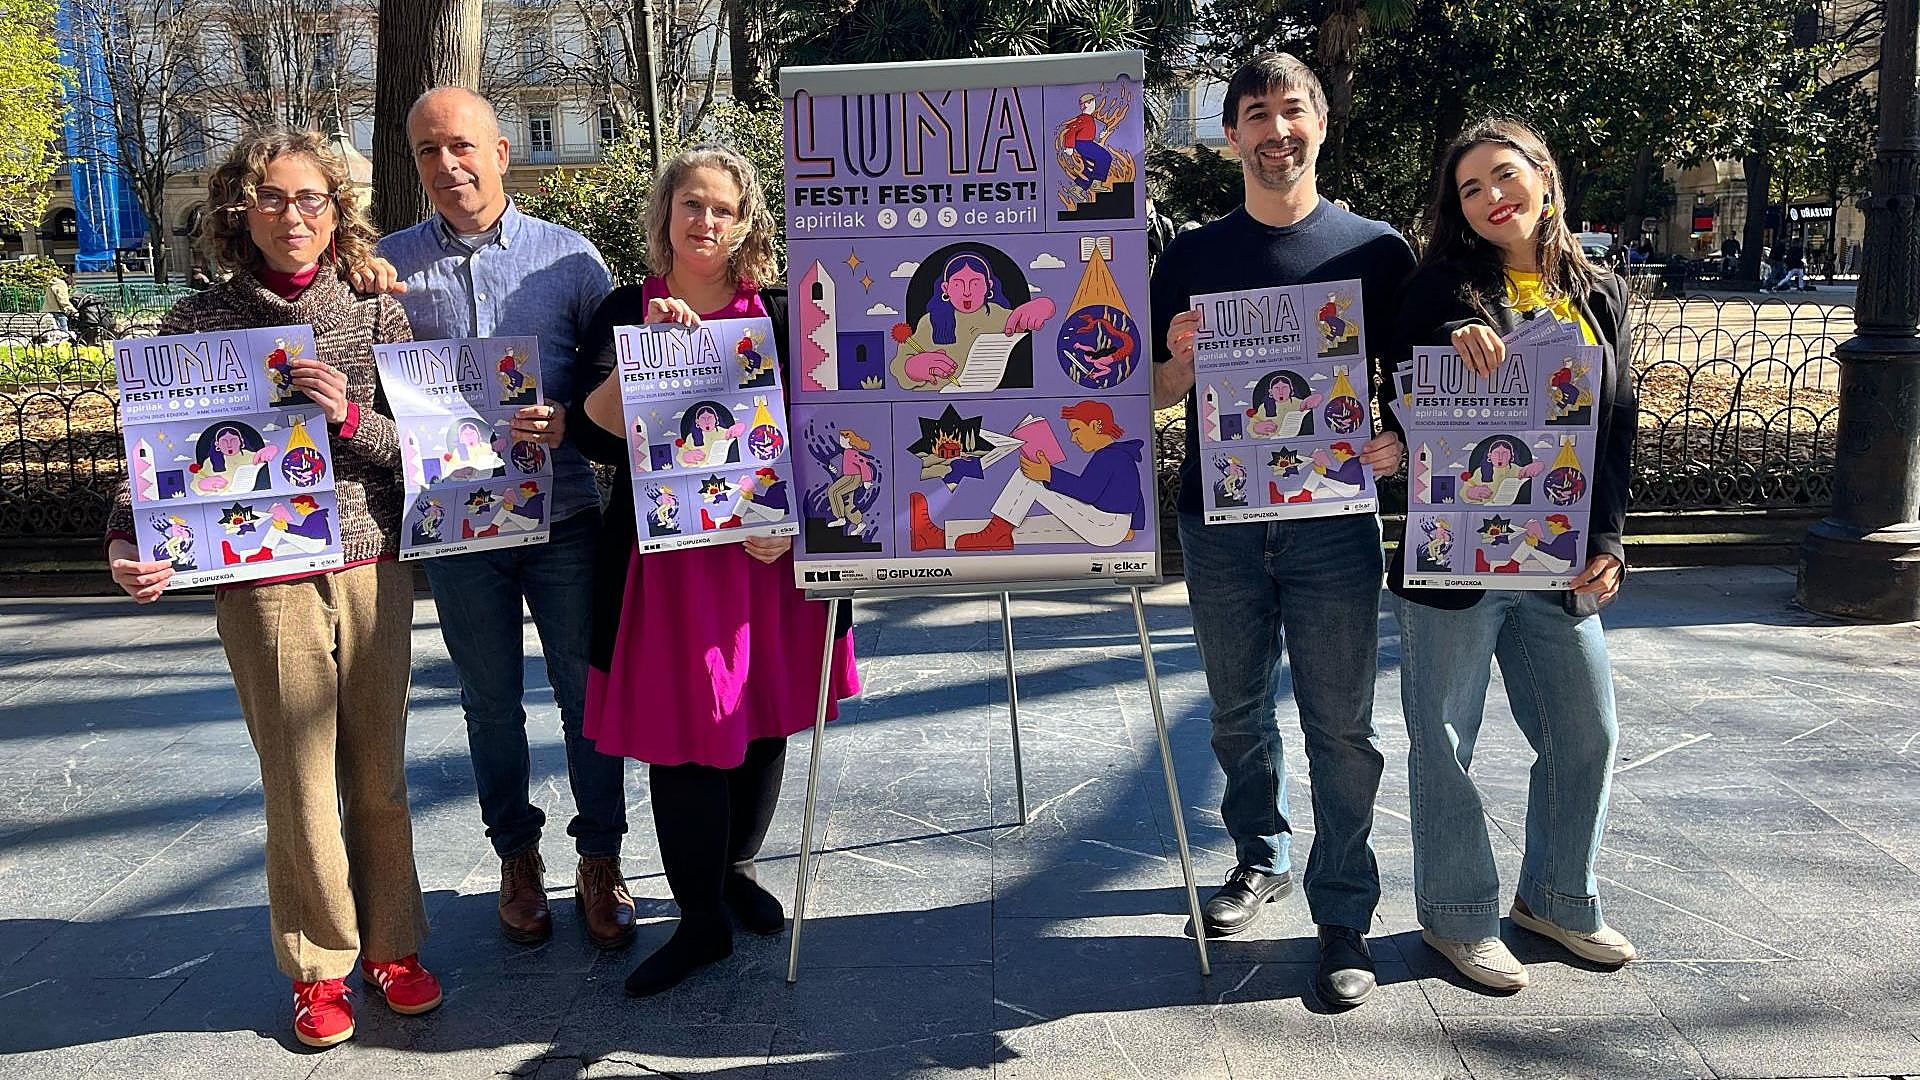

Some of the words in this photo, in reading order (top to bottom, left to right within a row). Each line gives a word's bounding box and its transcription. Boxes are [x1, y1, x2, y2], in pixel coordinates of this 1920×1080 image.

[794, 86, 1038, 179] LUMA
[795, 186, 869, 206] FEST!
[878, 183, 953, 205] FEST!
[962, 181, 1038, 203] FEST!
[795, 206, 865, 231] apirilak
[964, 207, 988, 225] de
[995, 205, 1038, 225] abril
[1195, 294, 1300, 340] LUMA
[619, 327, 721, 372] LUMA
[1197, 340, 1229, 351] FEST!
[1233, 337, 1265, 348] FEST!
[1268, 334, 1301, 345] FEST!
[119, 339, 247, 391] LUMA
[624, 372, 655, 382] FEST!
[658, 369, 689, 379] FEST!
[692, 366, 722, 376] FEST!
[126, 390, 164, 402] FEST!
[169, 386, 207, 399] FEST!
[211, 382, 249, 395] FEST!
[452, 383, 483, 394] FEST!
[1416, 397, 1450, 406] FEST!
[1454, 397, 1489, 406] FEST!
[1493, 397, 1529, 406] FEST!
[1507, 409, 1528, 417] abril
[889, 568, 952, 579] GIPUZKOA
[1114, 561, 1148, 571] elkar
[199, 572, 235, 583] GIPUZKOA
